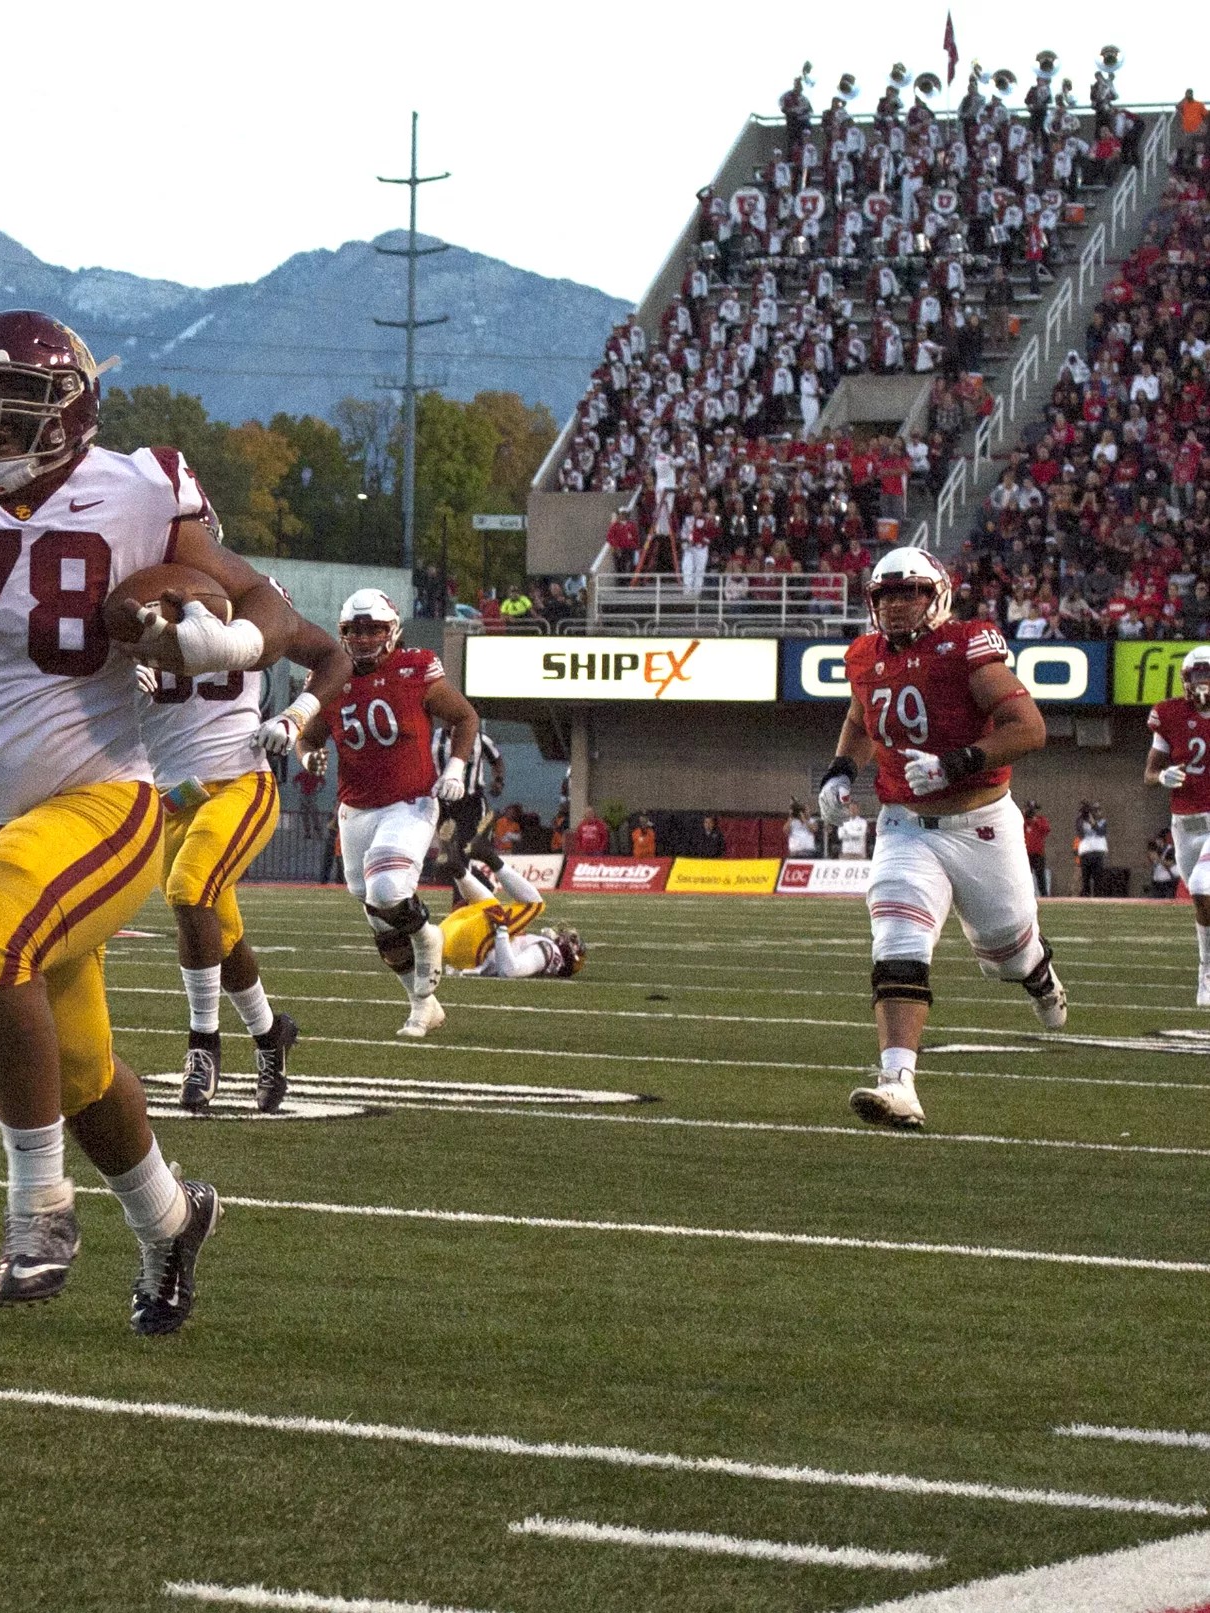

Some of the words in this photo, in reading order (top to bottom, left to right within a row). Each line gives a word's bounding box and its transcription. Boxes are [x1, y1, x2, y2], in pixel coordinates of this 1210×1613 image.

[340, 698, 399, 750] 50
[871, 685, 930, 748] 79
[845, 867, 871, 880] OLS
